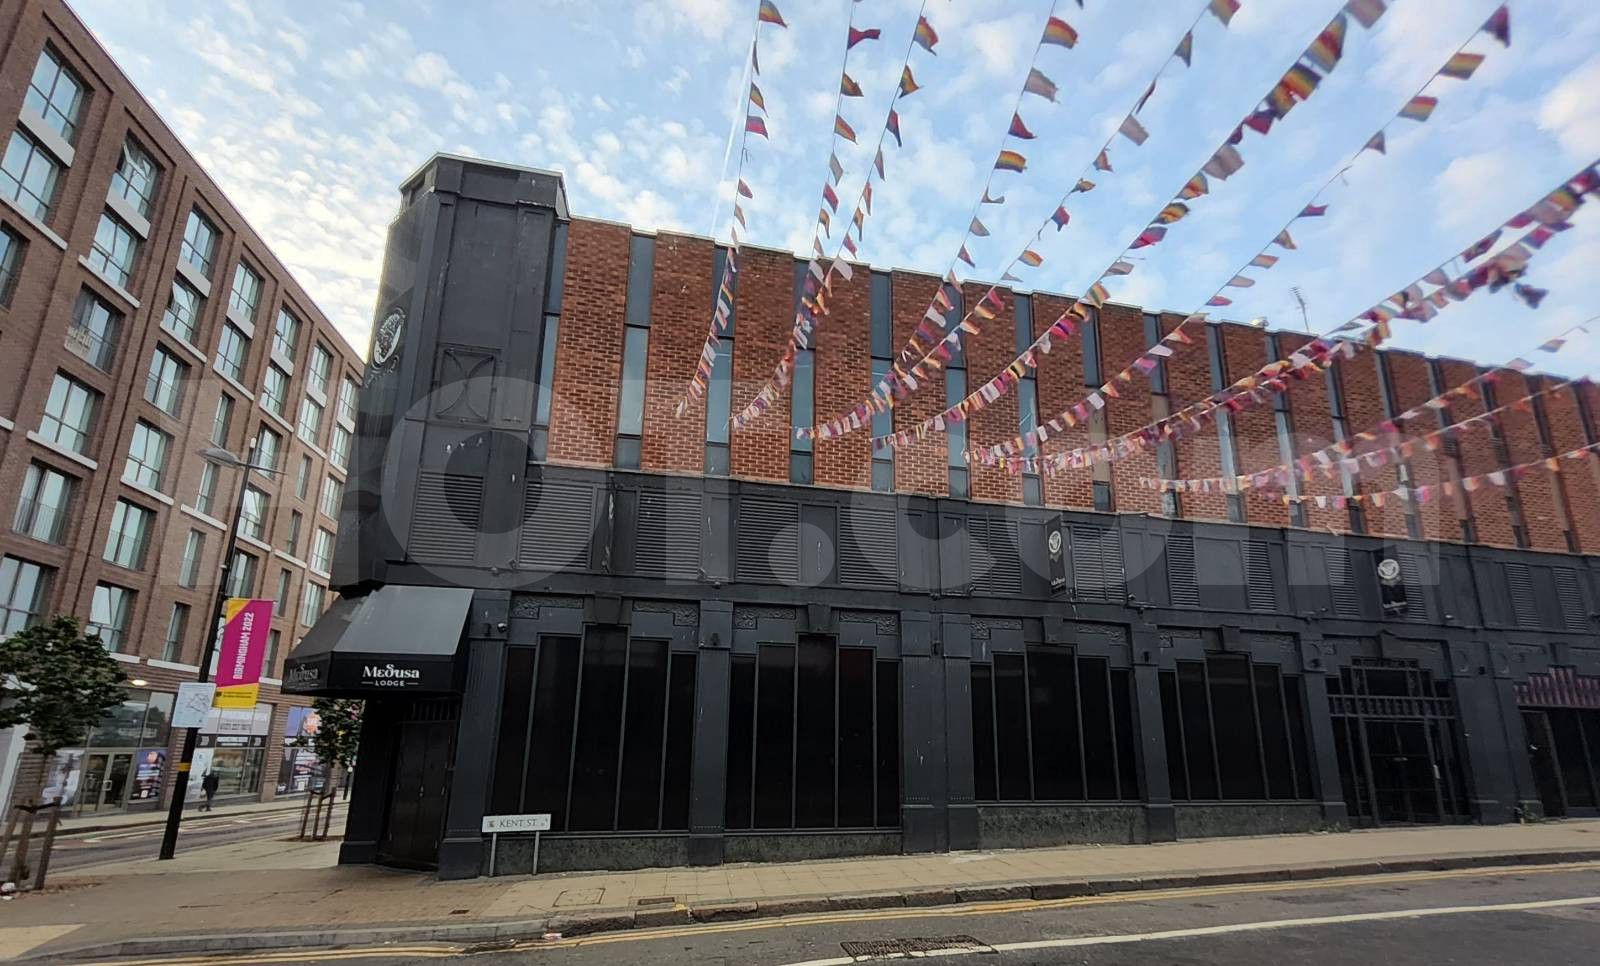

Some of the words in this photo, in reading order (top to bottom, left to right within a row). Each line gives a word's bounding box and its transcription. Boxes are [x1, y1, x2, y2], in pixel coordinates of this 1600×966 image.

[232, 632, 251, 680] BIRMINGHAM
[242, 611, 255, 632] 2022
[362, 663, 420, 678] Medusa
[500, 819, 524, 828] KENT
